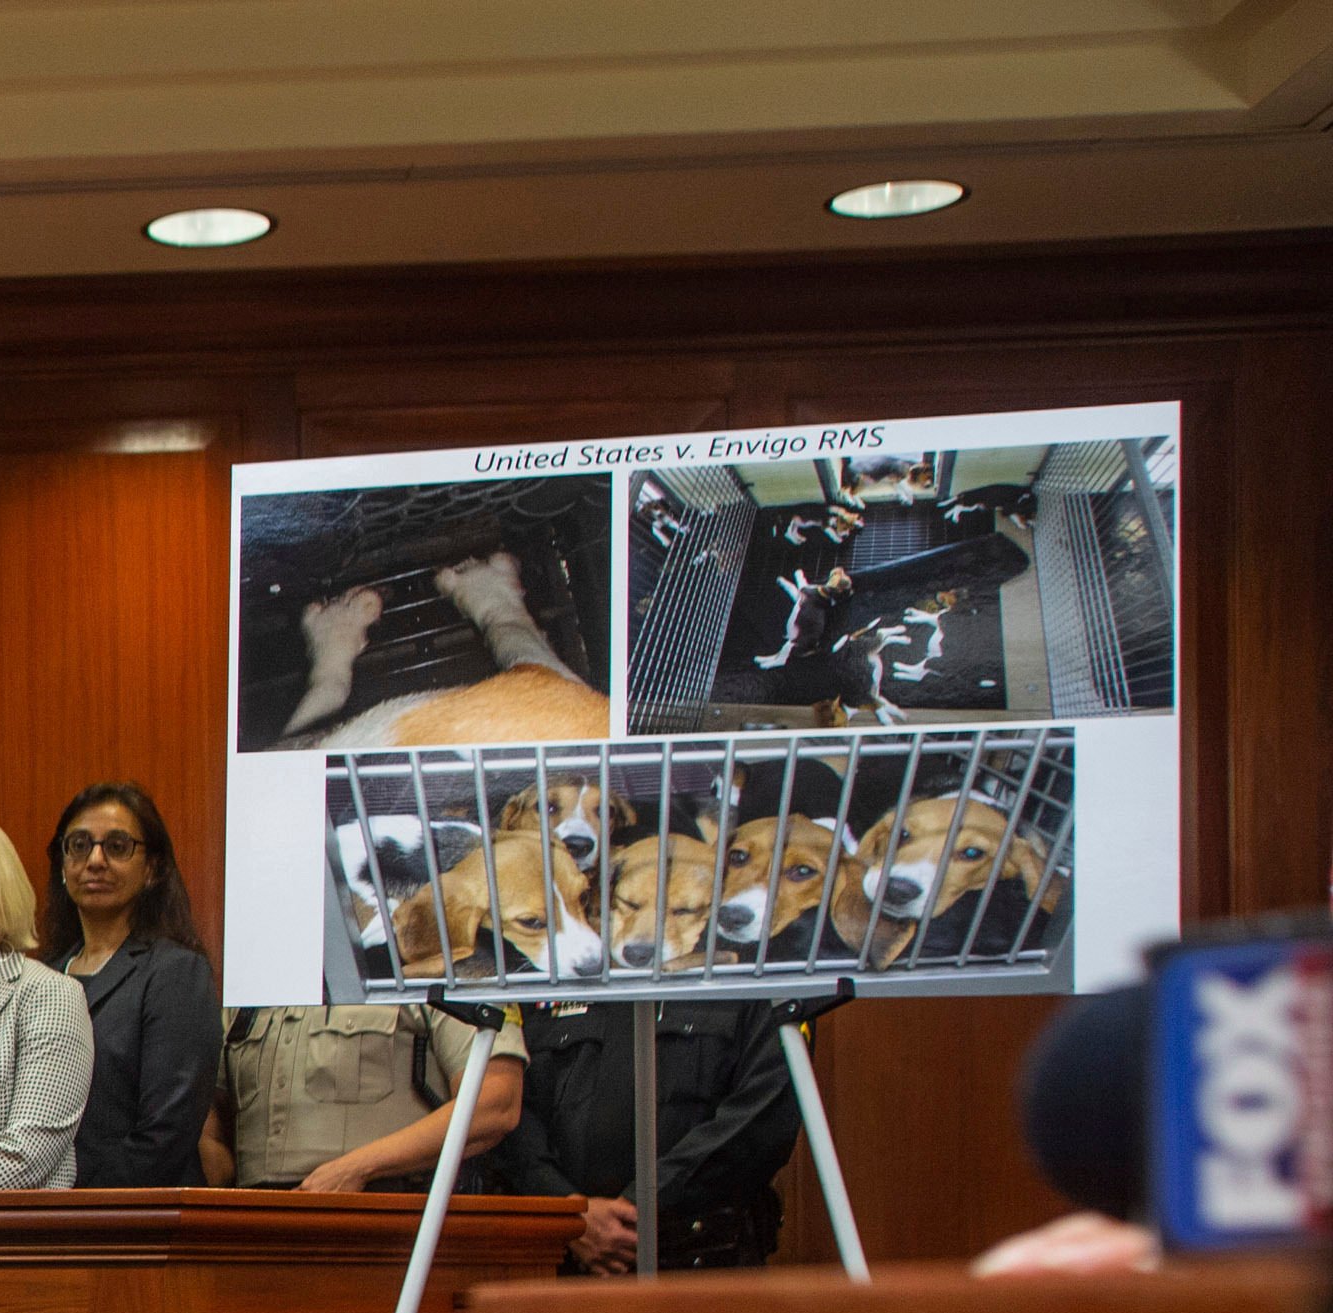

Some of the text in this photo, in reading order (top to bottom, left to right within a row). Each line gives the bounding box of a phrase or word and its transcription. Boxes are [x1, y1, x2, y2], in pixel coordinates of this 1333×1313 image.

[474, 425, 885, 473] United States v. Envigo RMS
[1195, 970, 1309, 1234] FOX
